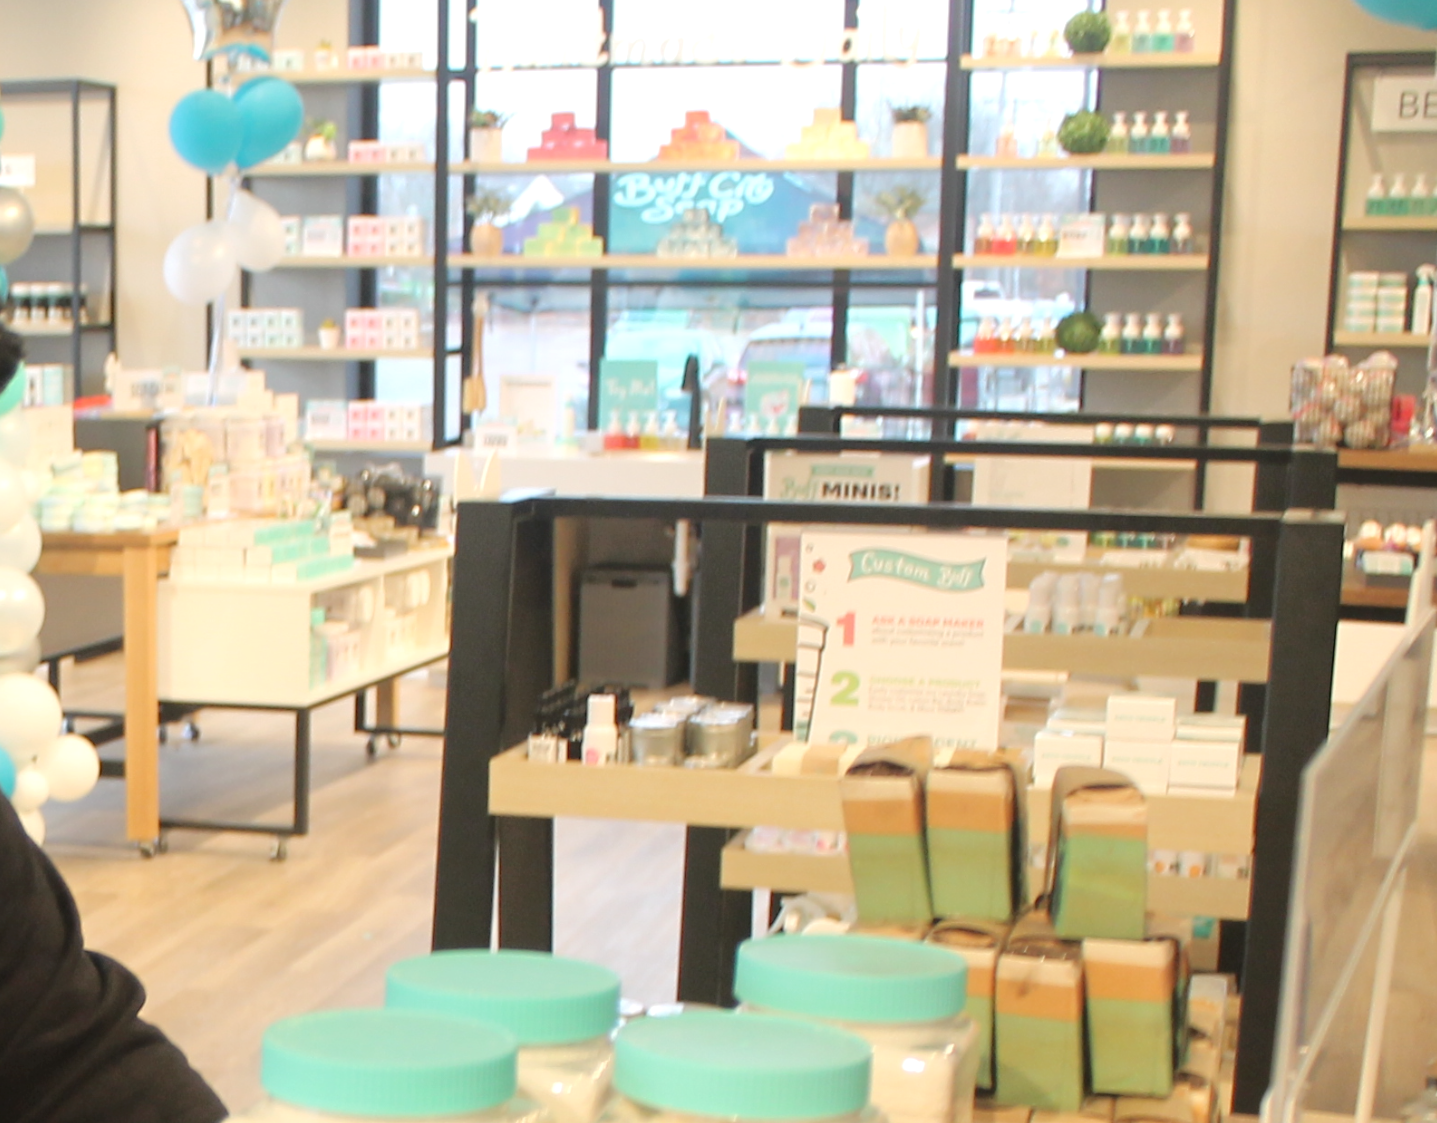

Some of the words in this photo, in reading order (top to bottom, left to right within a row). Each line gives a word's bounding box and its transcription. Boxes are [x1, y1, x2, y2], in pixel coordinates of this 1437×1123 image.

[614, 172, 707, 208] Buff
[821, 481, 901, 501] MINIS!
[861, 551, 931, 582] Custom
[836, 611, 857, 647] 1
[908, 616, 940, 627] SOAP
[943, 617, 984, 628] MAKER
[830, 670, 861, 707] 2
